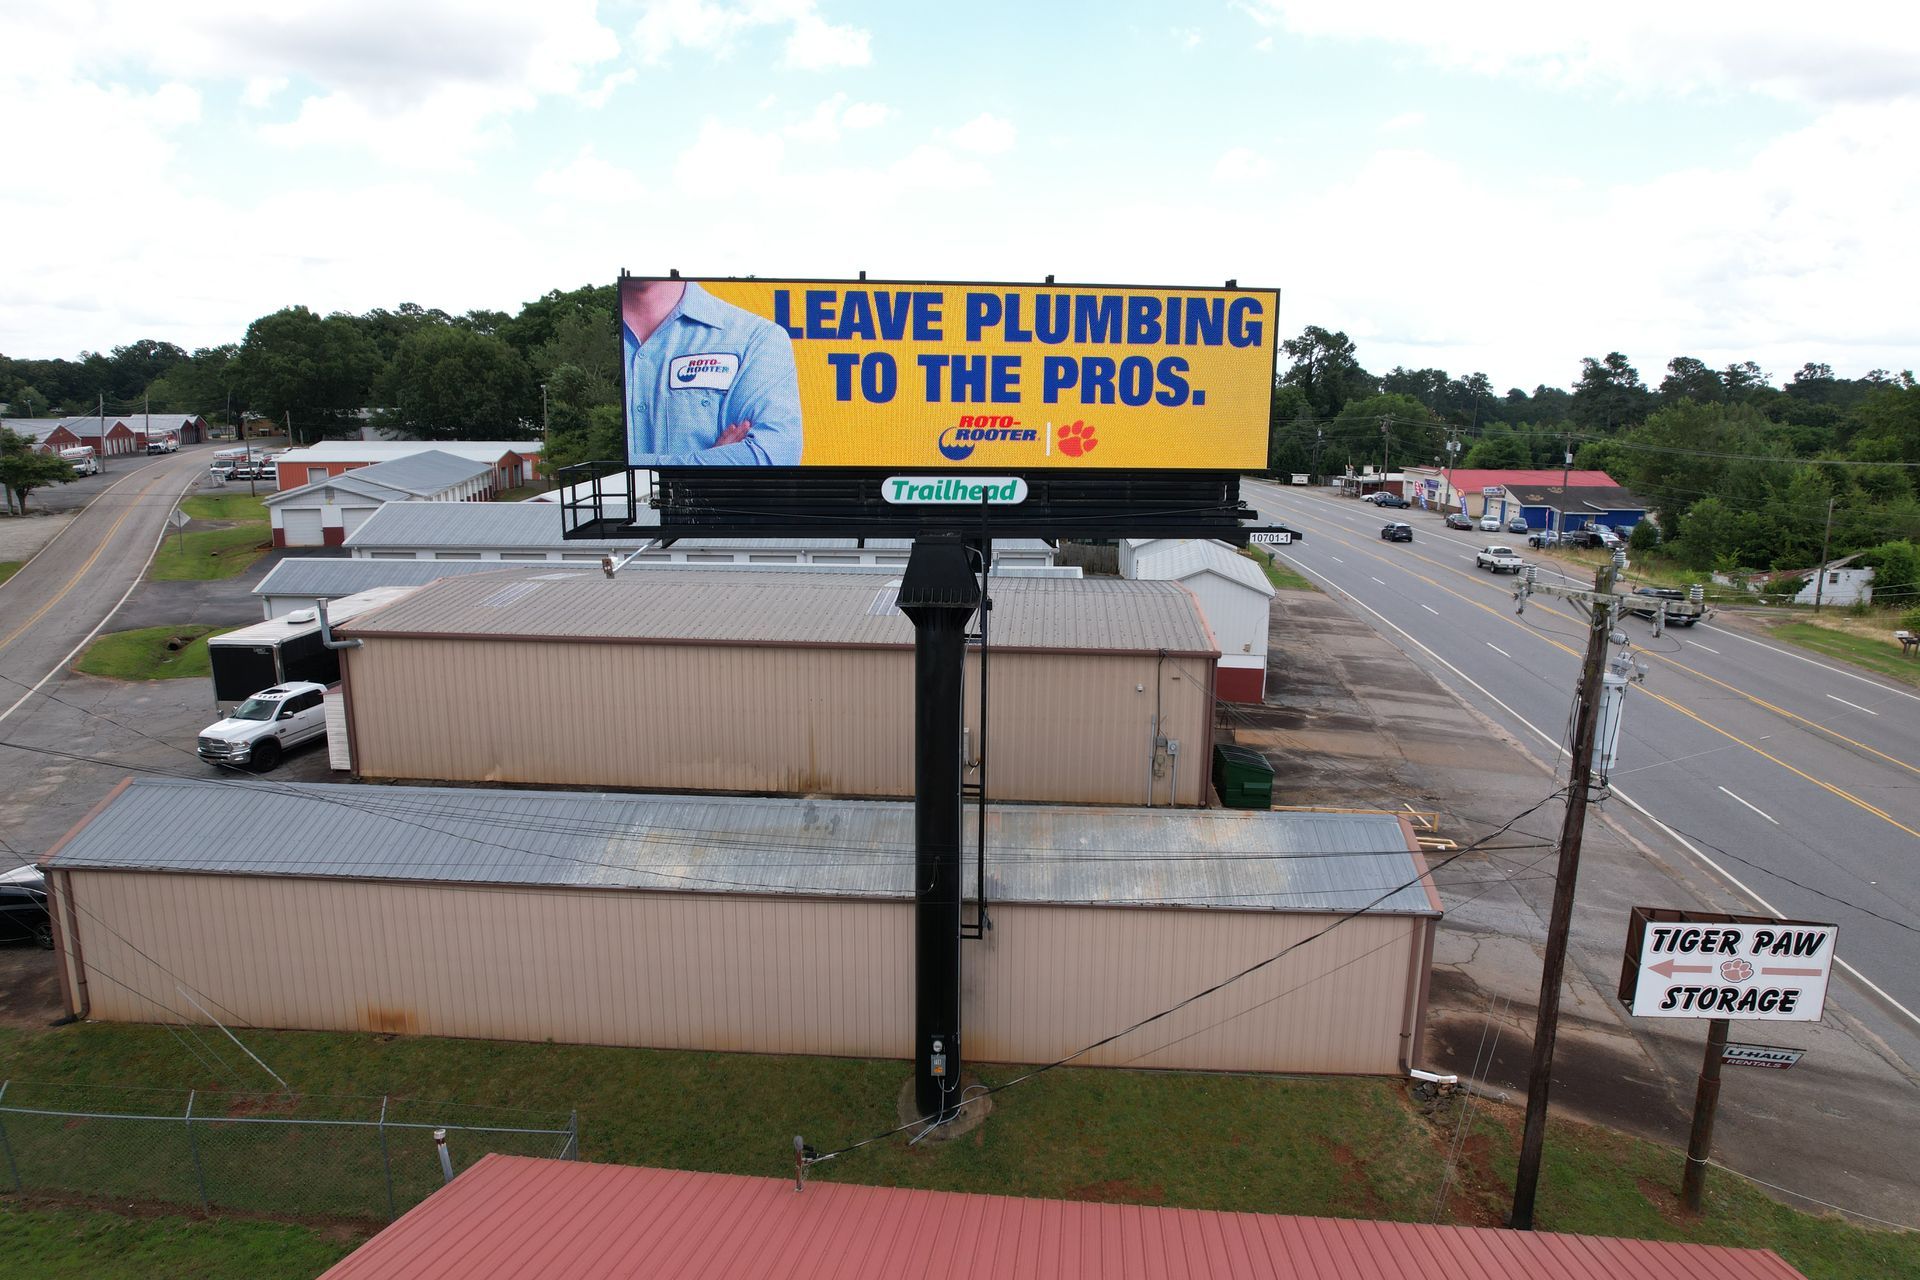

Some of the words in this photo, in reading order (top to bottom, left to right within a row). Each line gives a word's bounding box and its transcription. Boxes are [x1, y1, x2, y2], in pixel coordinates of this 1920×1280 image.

[774, 289, 944, 341] LEAVE
[965, 292, 1264, 348] PLUMBING
[827, 352, 898, 404] TO
[917, 354, 1022, 404] THE
[1042, 355, 1206, 407] PROS.
[959, 415, 1021, 428] ROTO-
[955, 428, 1038, 441] ROOTER
[891, 479, 1018, 501] Trailhead
[1251, 533, 1290, 543] 10701-1
[1653, 929, 1742, 955] TIGER
[1752, 931, 1826, 956] PAW
[1660, 986, 1800, 1013] STORAGE
[1726, 1058, 1782, 1068] RENTALS
[1727, 1049, 1794, 1061] U-HAUL
